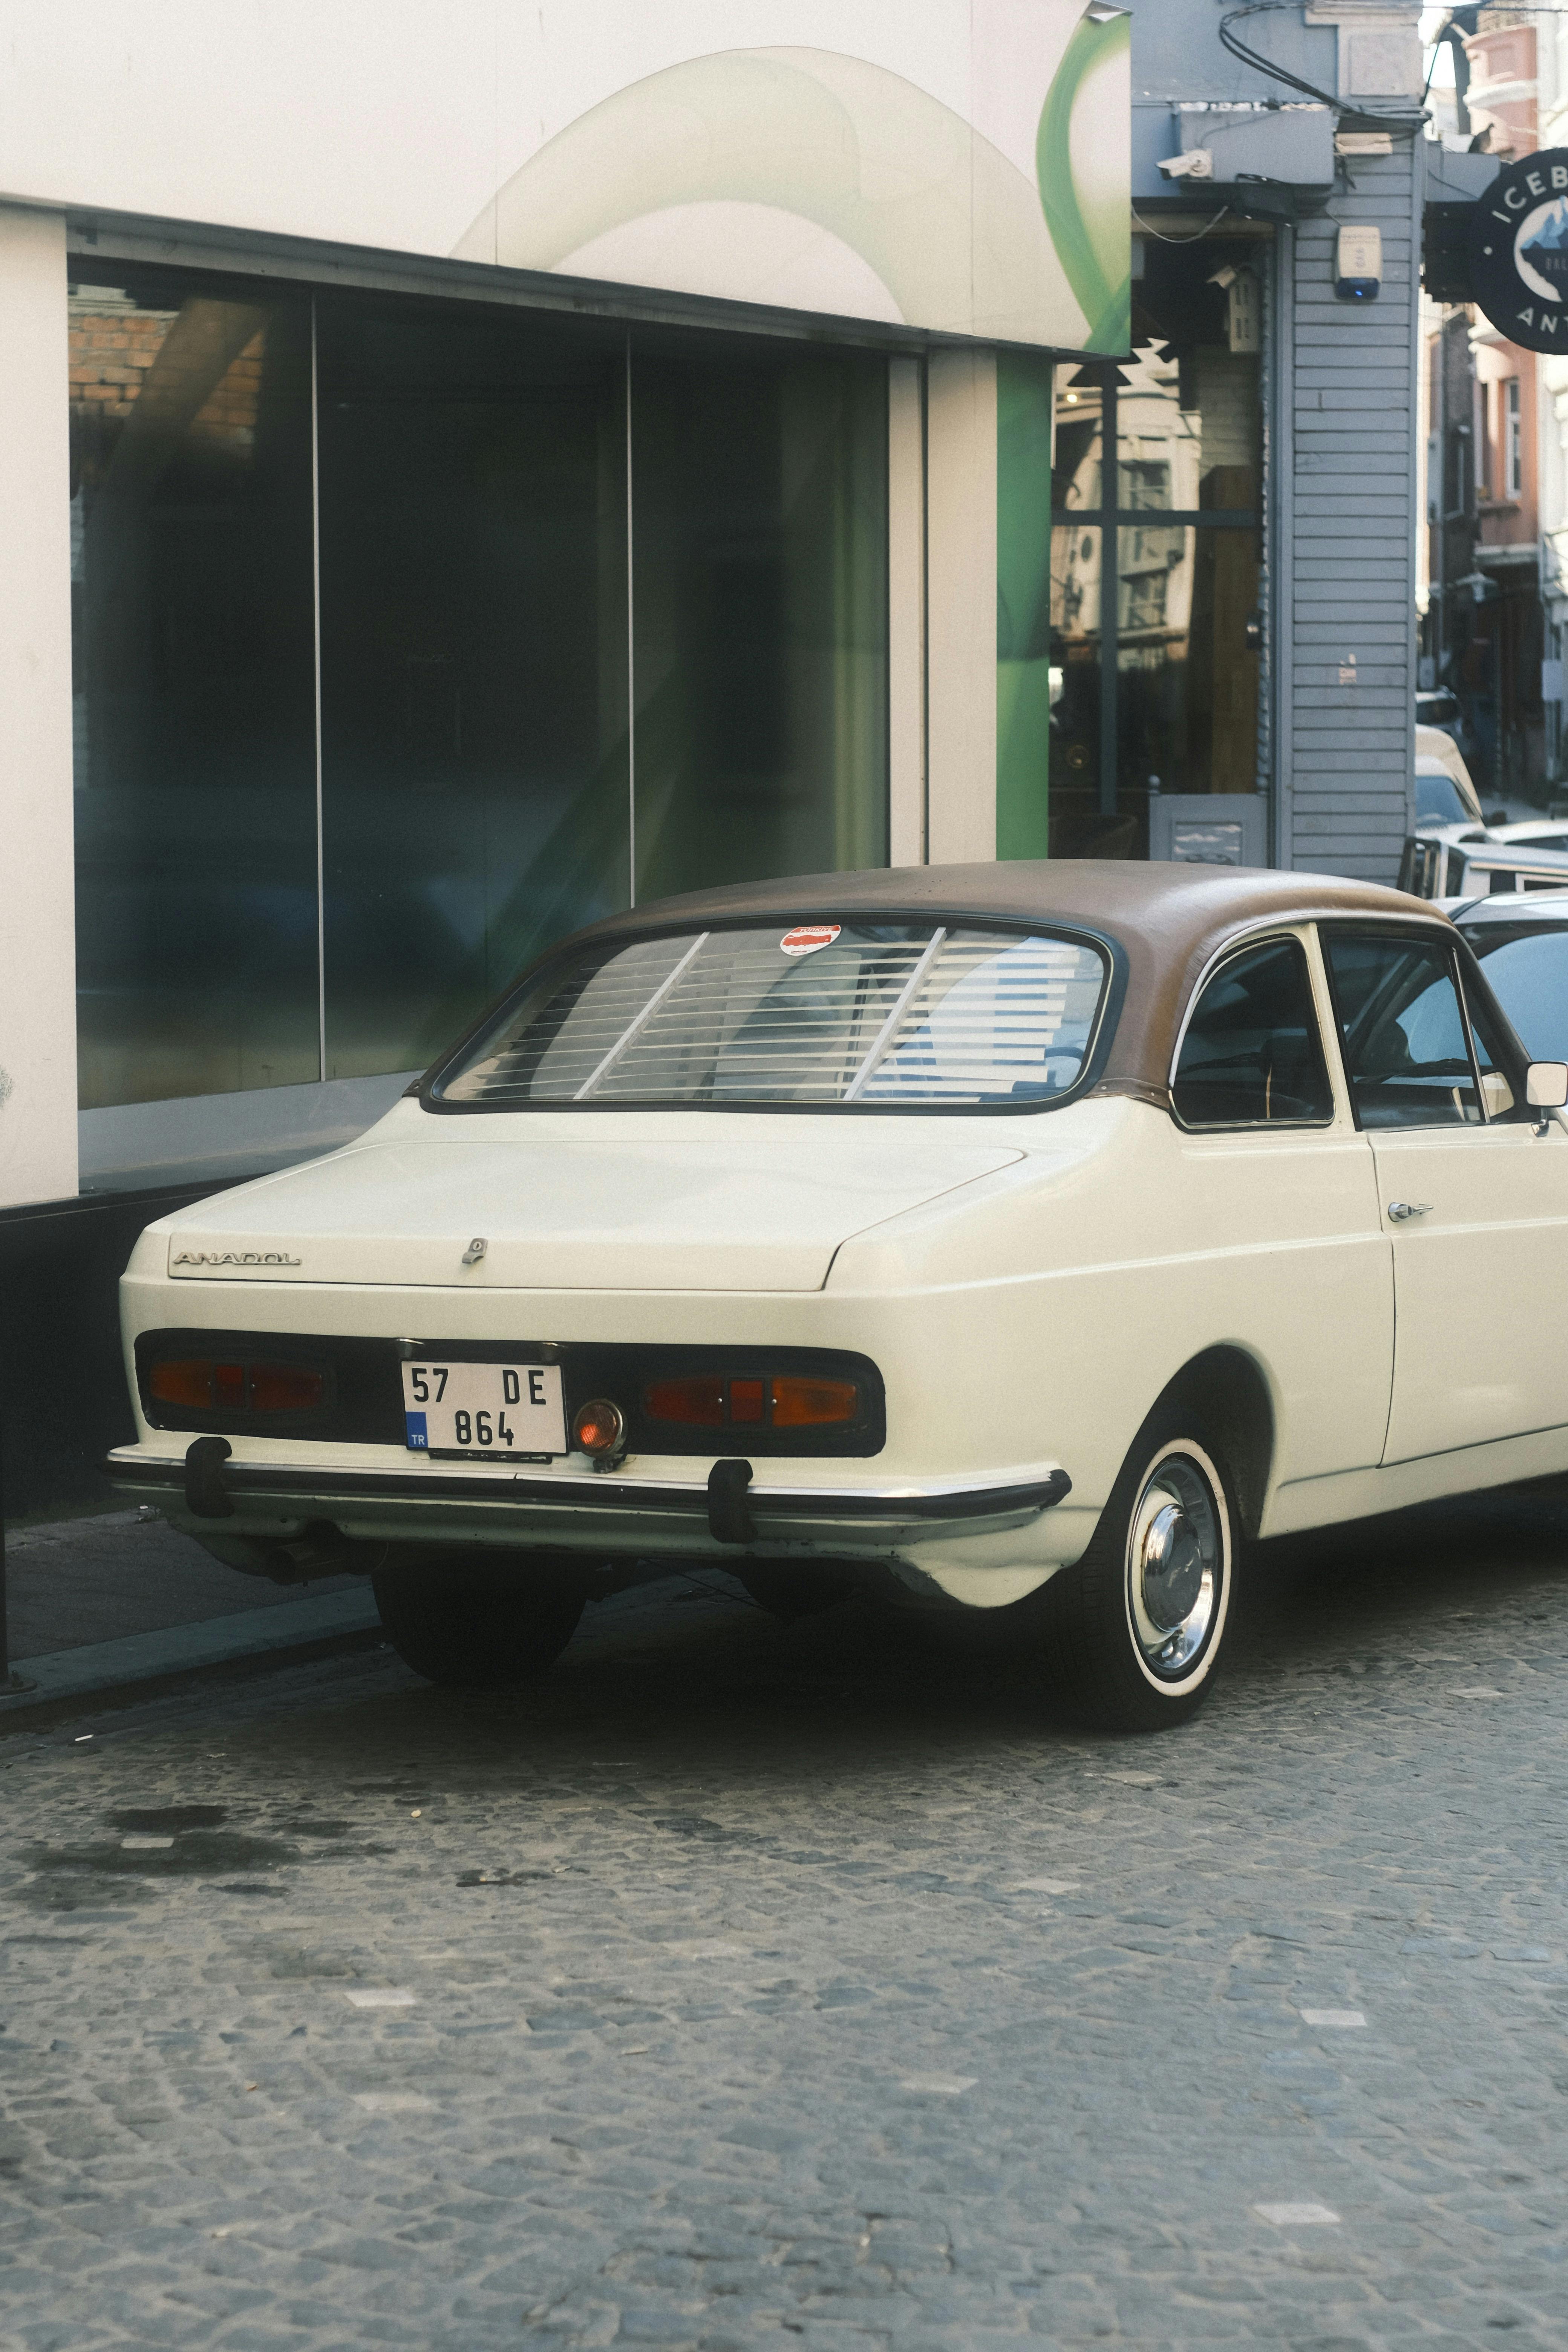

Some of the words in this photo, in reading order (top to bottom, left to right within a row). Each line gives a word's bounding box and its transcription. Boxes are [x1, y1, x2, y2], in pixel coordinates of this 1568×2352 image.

[1516, 306, 1568, 334] AN
[172, 1252, 302, 1265] ANADOL
[412, 1368, 449, 1403] 57
[502, 1369, 547, 1405] DE
[411, 1434, 425, 1445] TR
[455, 1410, 514, 1446] 864
